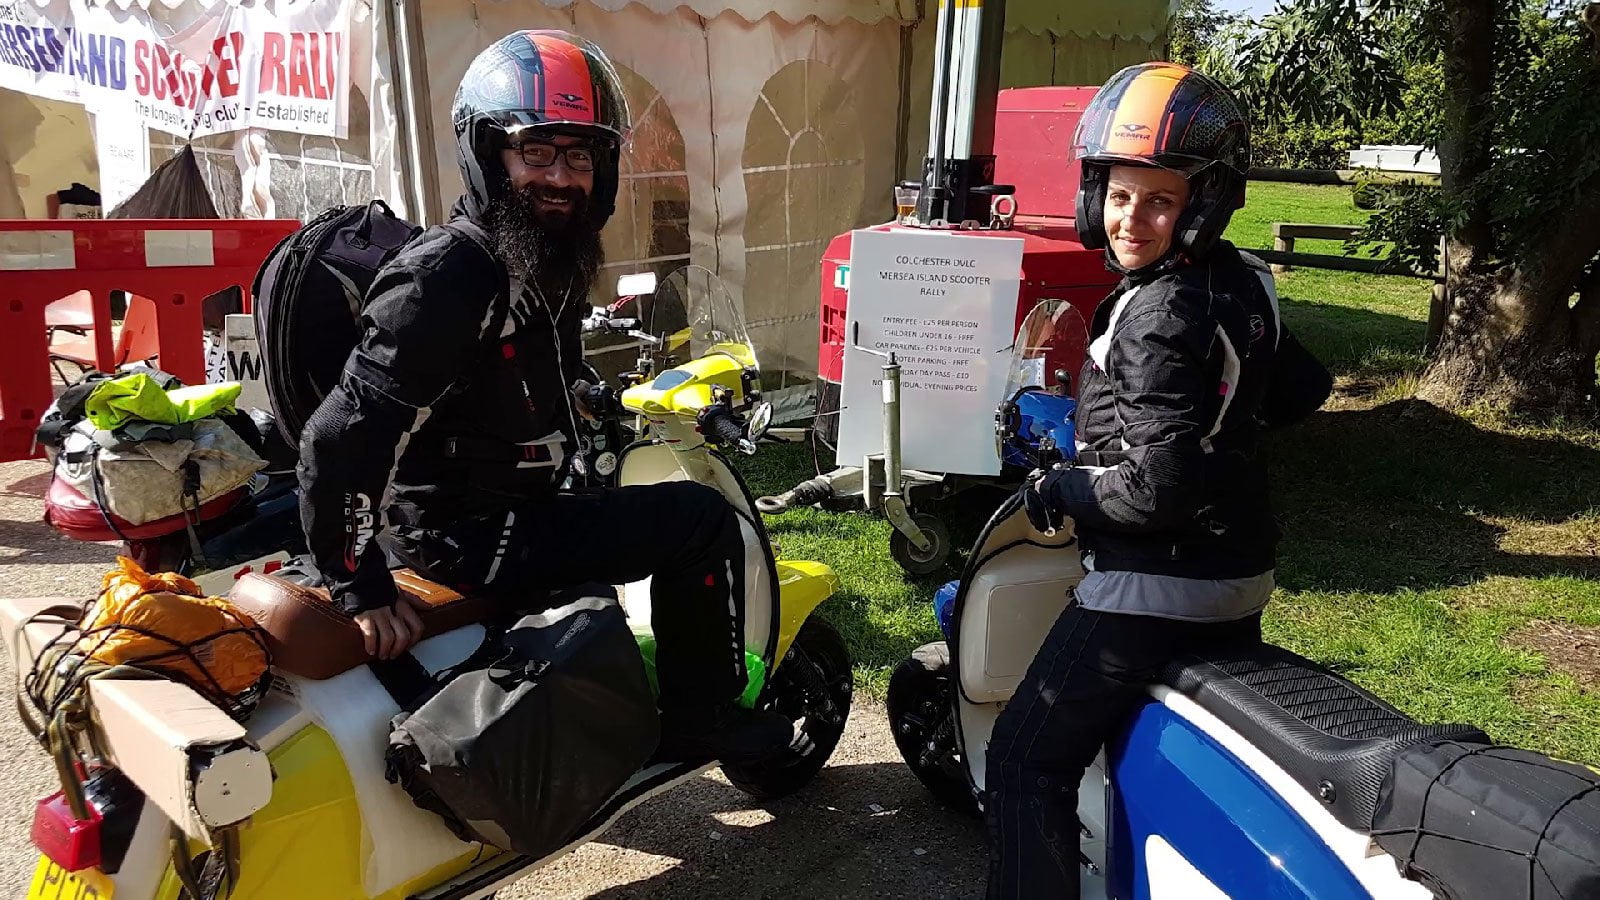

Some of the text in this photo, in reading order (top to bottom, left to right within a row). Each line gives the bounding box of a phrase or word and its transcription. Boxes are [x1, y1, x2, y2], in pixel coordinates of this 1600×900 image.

[552, 99, 589, 112] VEMAR
[134, 99, 149, 117] The
[256, 101, 329, 124] Established
[1115, 132, 1150, 140] VEMAR
[896, 255, 951, 266] COLCHESTER
[879, 271, 991, 285] MERSEA ISLAND SCOOTER
[920, 287, 946, 296] RALLY
[882, 316, 904, 324] ENTRY
[951, 320, 978, 328] PERSON
[884, 330, 917, 338] CHILDREN
[890, 342, 920, 351] PARKING
[939, 345, 952, 353] PER
[953, 346, 981, 354] VEHICLE
[917, 357, 947, 365] PARKING
[924, 382, 954, 390] EVENING
[954, 384, 978, 392] PRICES
